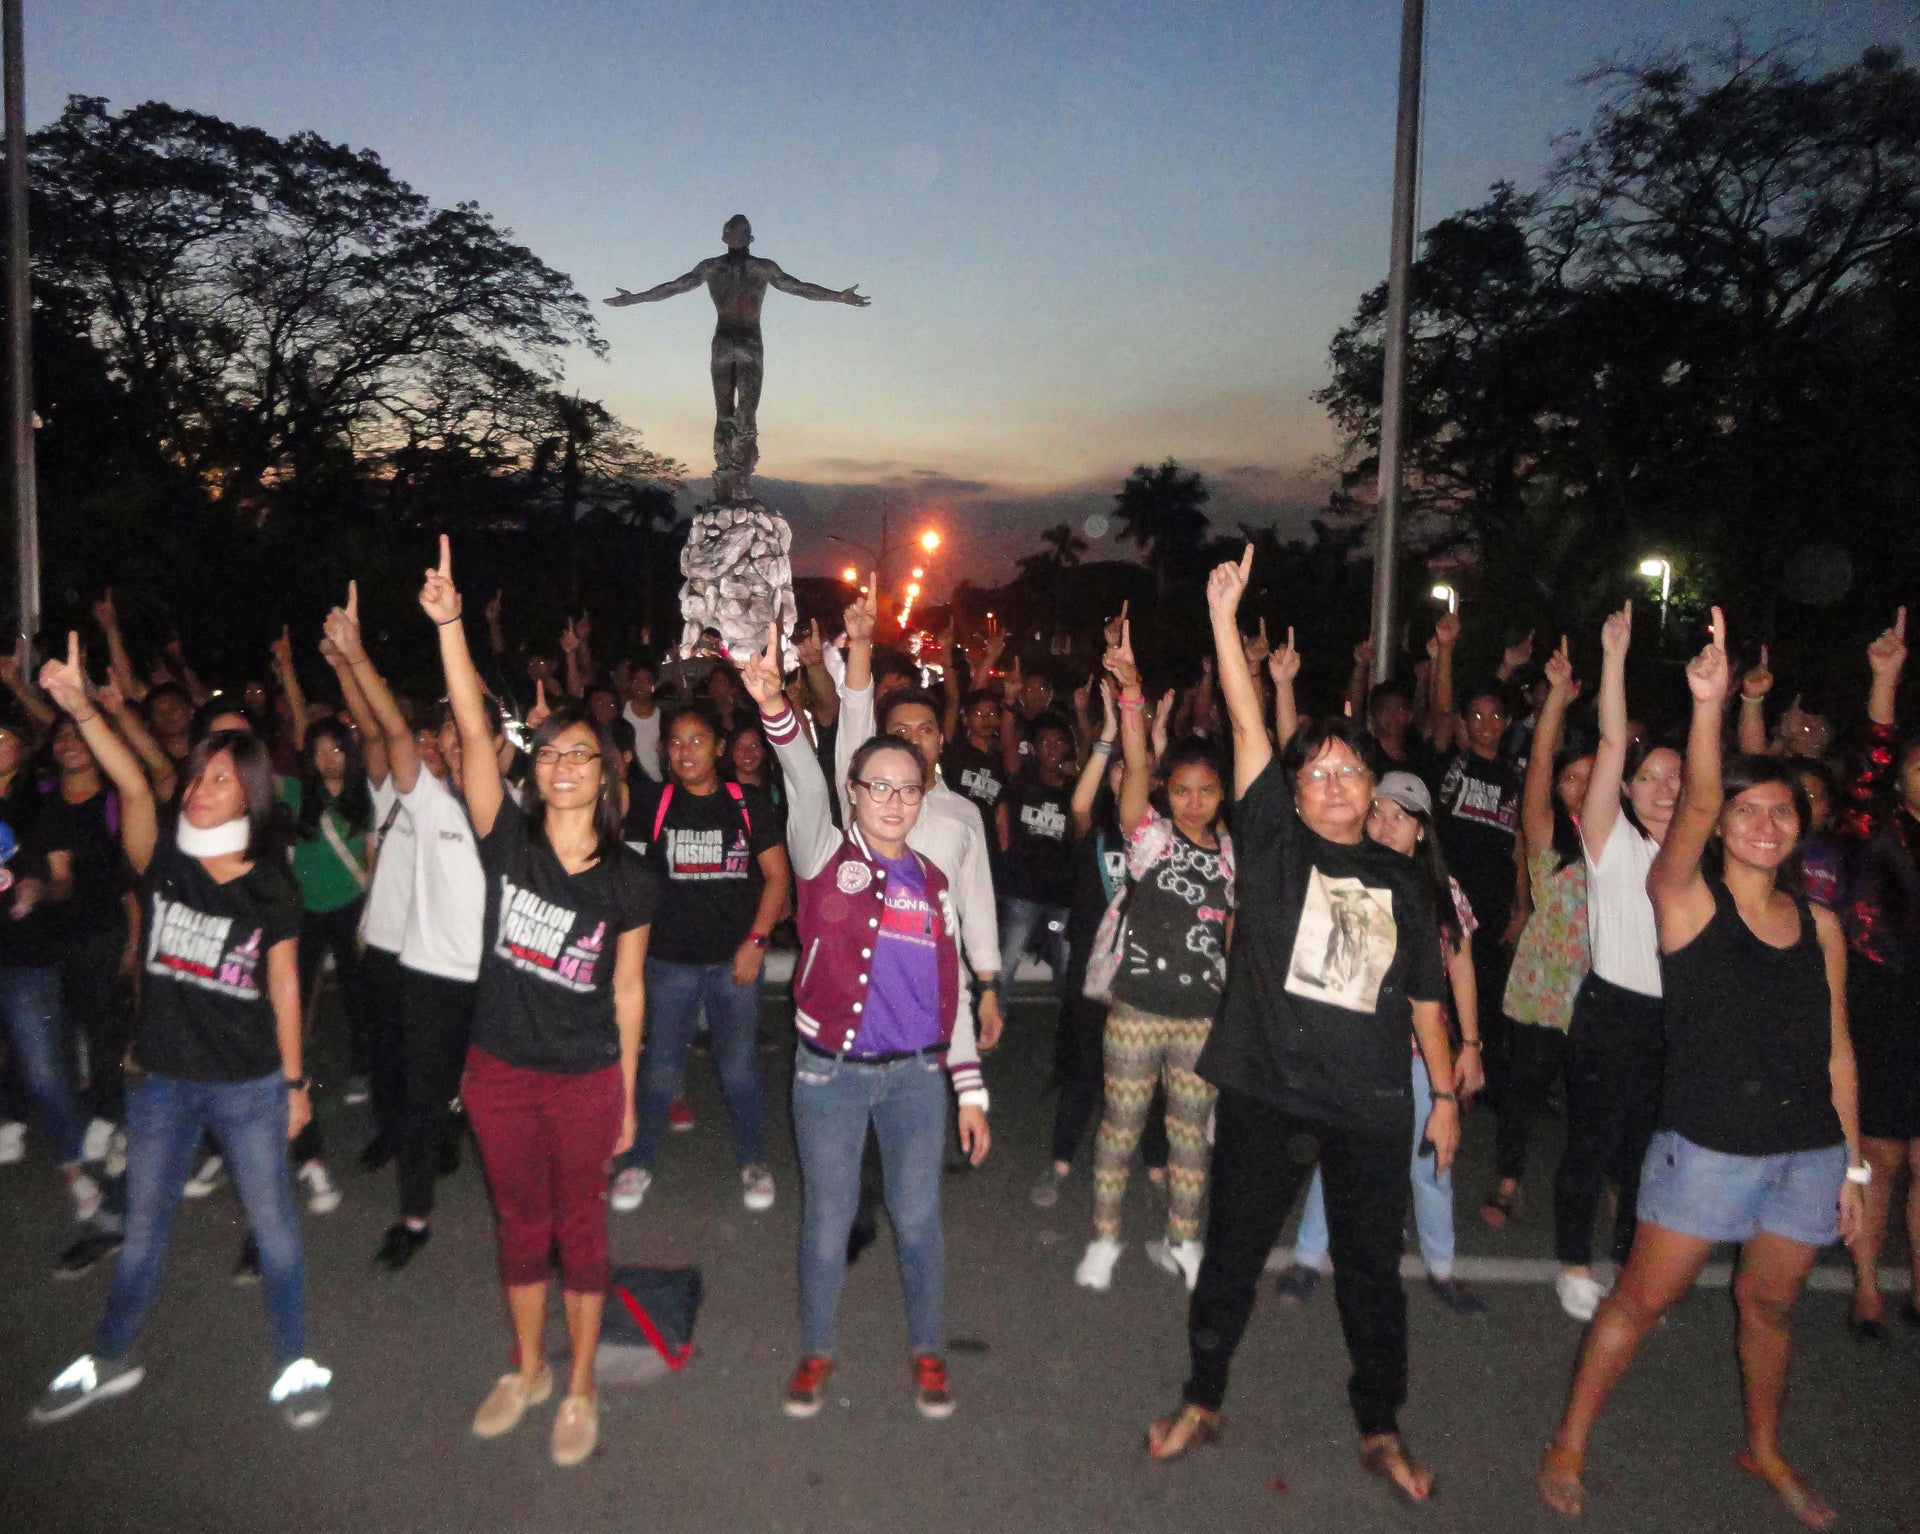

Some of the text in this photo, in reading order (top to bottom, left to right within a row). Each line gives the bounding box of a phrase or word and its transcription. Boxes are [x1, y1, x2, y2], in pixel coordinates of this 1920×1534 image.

[675, 843, 722, 865] RISING
[677, 829, 722, 845] BILLION
[511, 888, 577, 935] BILLION
[506, 911, 565, 961] RISING
